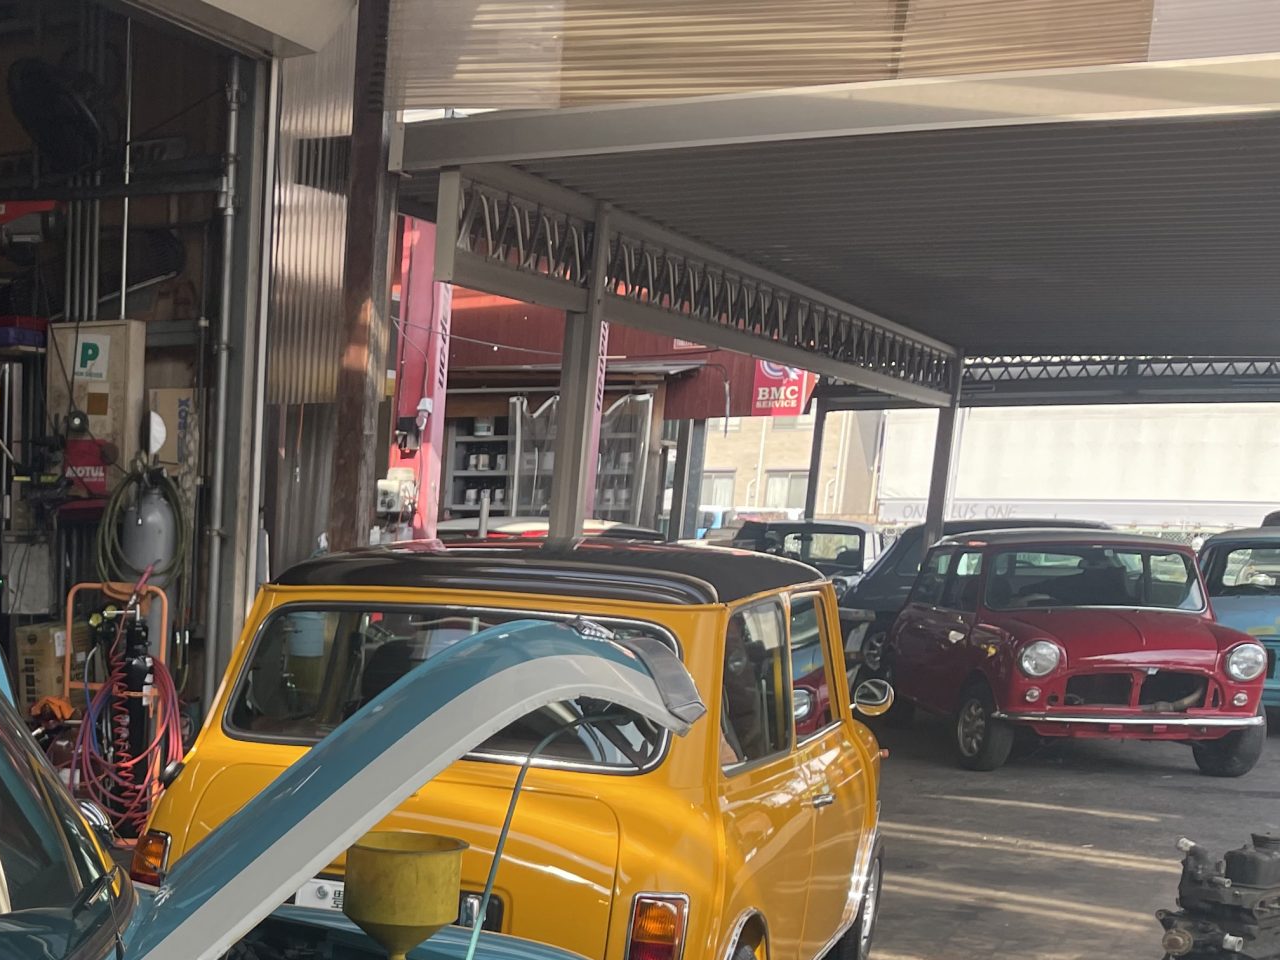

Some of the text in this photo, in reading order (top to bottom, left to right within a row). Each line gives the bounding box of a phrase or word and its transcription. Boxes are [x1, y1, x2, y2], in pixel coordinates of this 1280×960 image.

[80, 342, 100, 368] P
[758, 386, 799, 401] BMC
[756, 399, 798, 409] SERVICE
[65, 465, 105, 478] MOTUL
[902, 503, 1019, 519] ON LUS ONE
